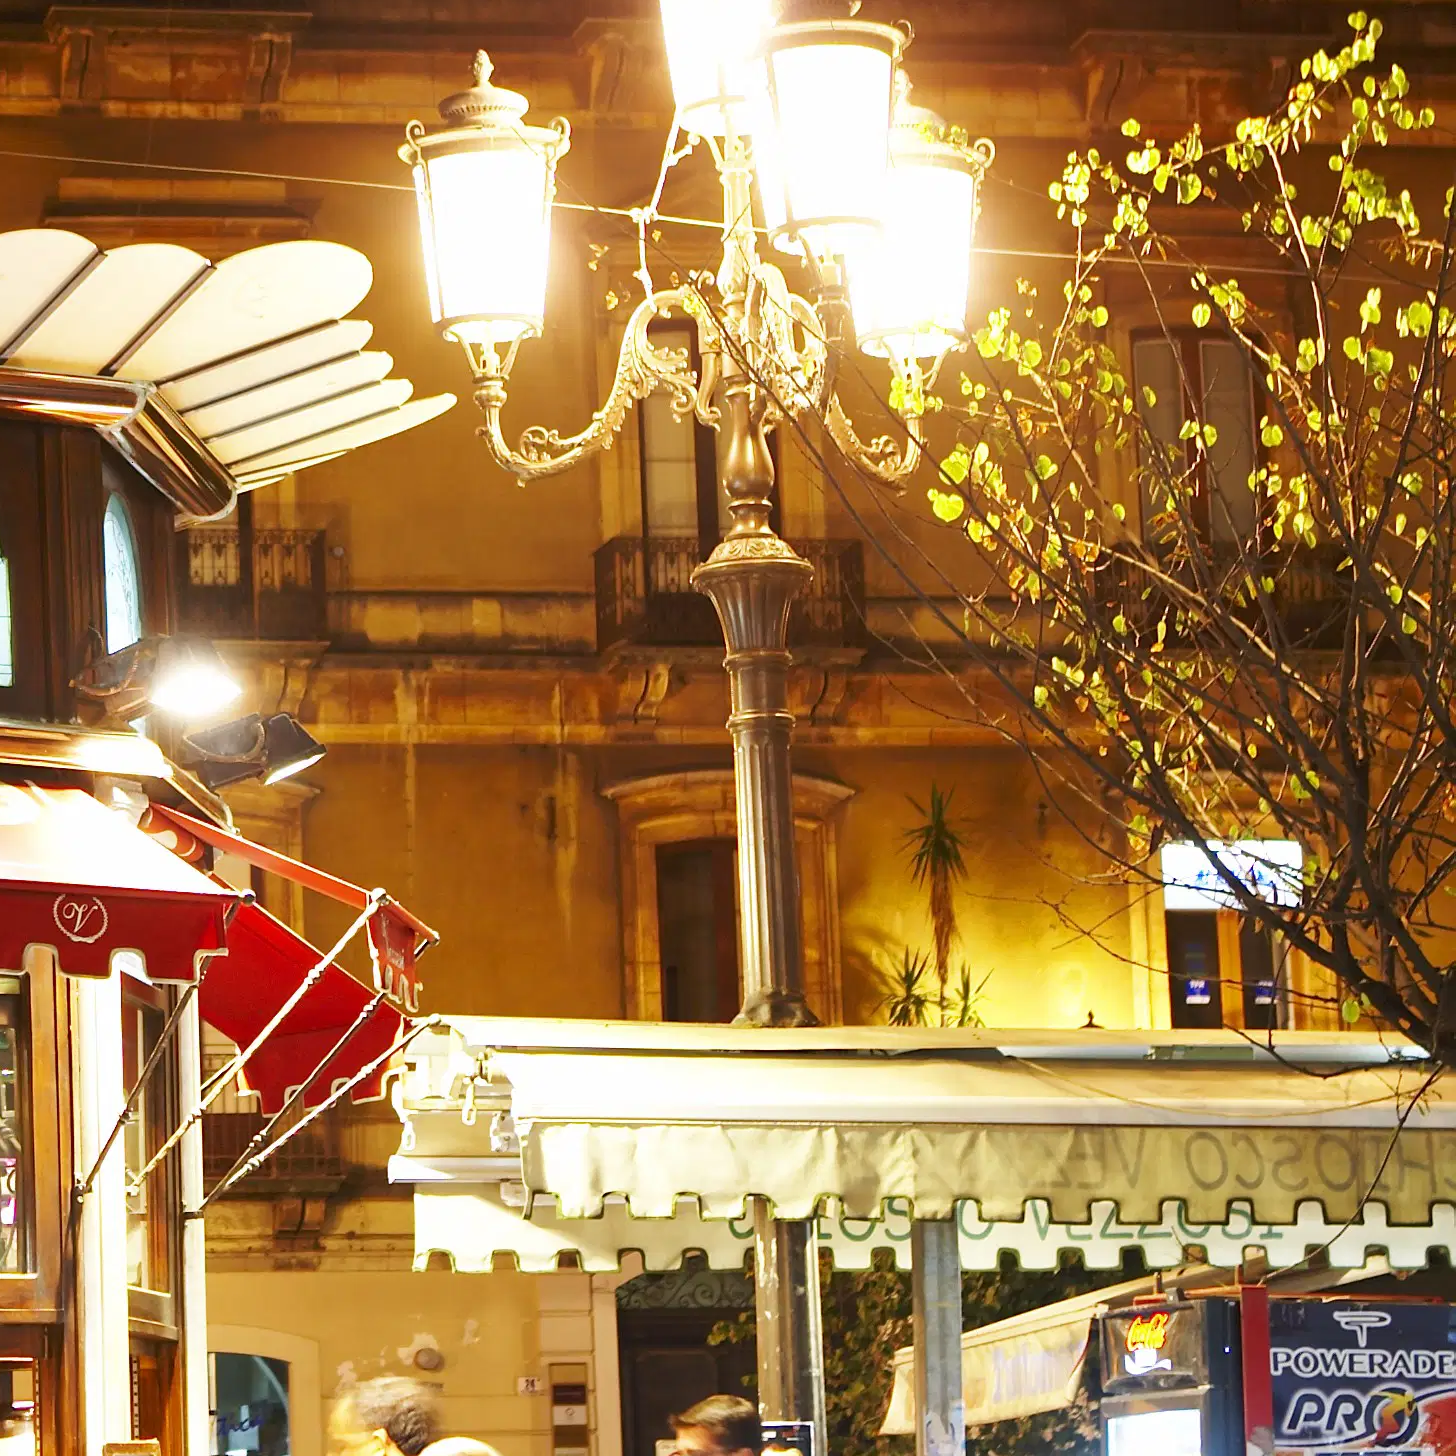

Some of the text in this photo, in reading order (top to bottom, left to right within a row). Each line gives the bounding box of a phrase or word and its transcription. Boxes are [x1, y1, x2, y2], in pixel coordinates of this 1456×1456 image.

[62, 902, 99, 933] V
[1270, 1347, 1455, 1378] POWERADE
[1282, 1385, 1420, 1448] PRO
